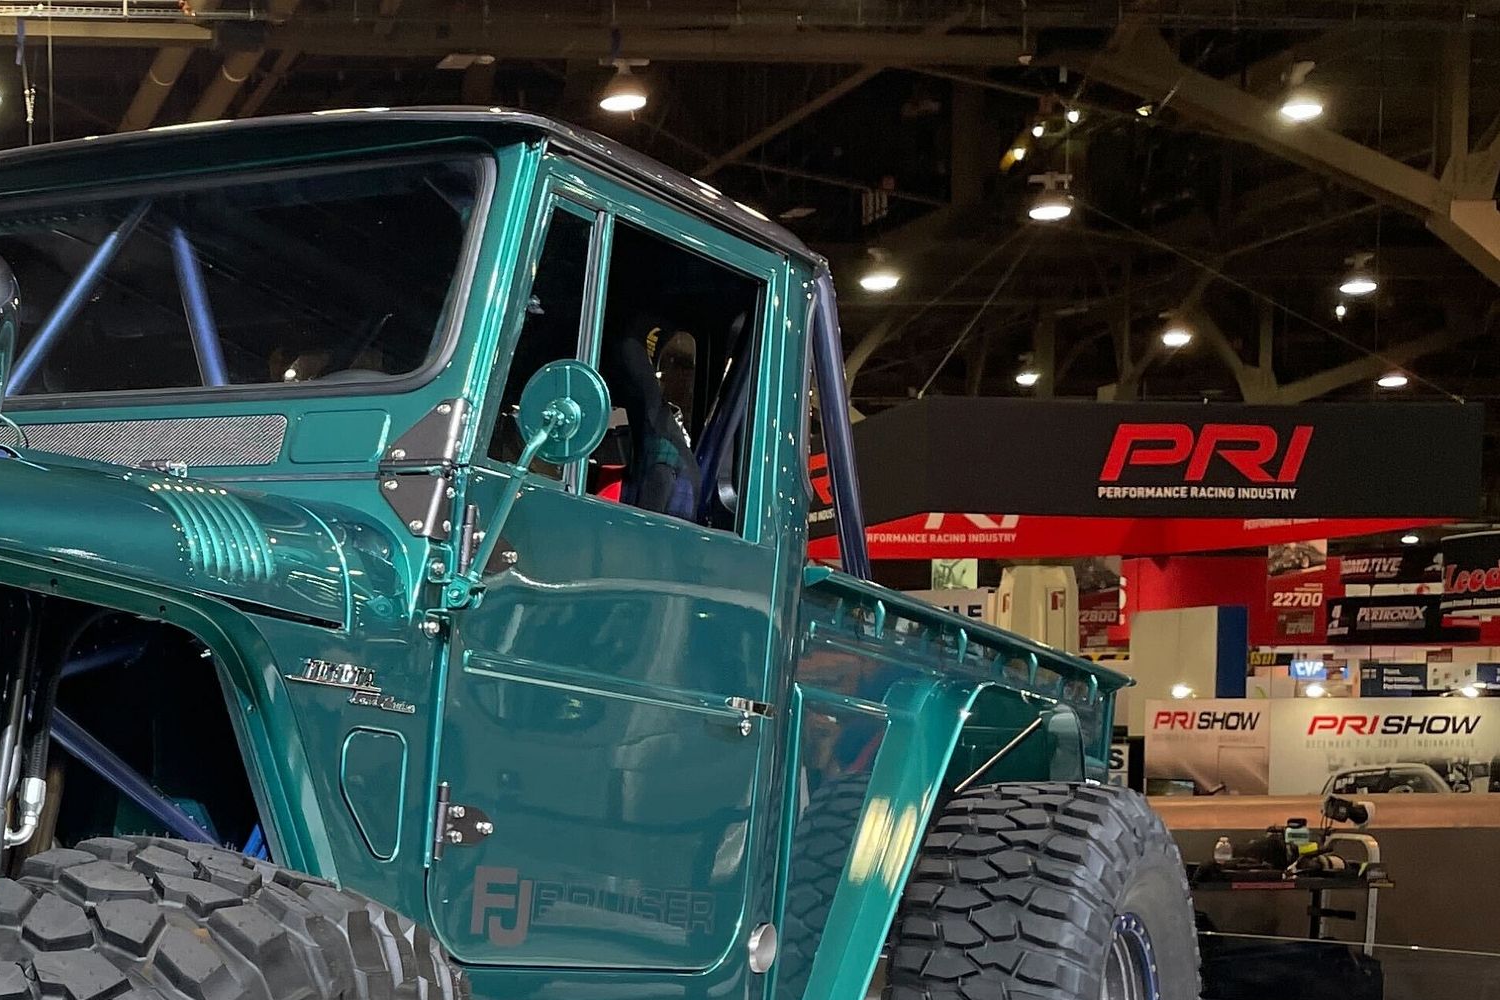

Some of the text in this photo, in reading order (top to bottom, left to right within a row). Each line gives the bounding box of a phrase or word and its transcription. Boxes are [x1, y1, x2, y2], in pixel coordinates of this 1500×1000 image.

[1100, 423, 1314, 482] PRI
[1098, 486, 1298, 501] PERFORMANCE RACING INDUSTRY
[867, 533, 1017, 543] RFORMANCE RACING INDUSTRY
[1272, 592, 1323, 607] 22700
[1080, 610, 1118, 622] 2800
[1154, 711, 1260, 731] PRI SHOW
[1307, 714, 1481, 735] PRI SHOW
